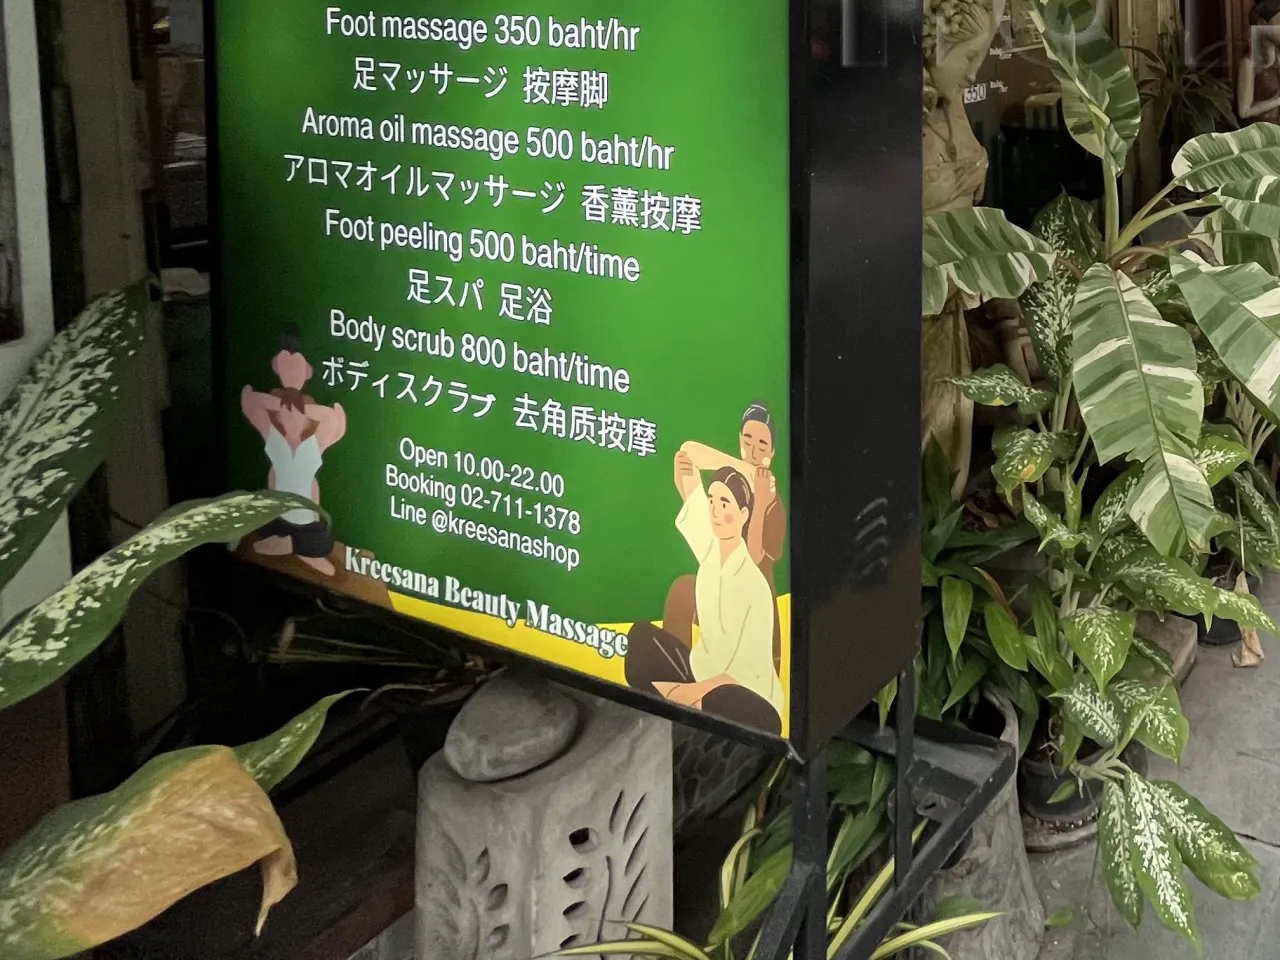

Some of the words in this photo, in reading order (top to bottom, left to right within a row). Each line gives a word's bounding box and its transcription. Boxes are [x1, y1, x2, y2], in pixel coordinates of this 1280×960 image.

[327, 8, 376, 36] Foot
[383, 17, 487, 50] massage
[495, 15, 540, 45] 350
[549, 16, 640, 50] baht/hr
[354, 57, 508, 98] 足マッサージ
[523, 66, 607, 108] 按摩脚
[302, 107, 374, 139] Aroma
[380, 115, 404, 142] oil
[412, 123, 519, 160] massage
[527, 127, 573, 159] 500
[582, 131, 674, 170] baht/hr
[284, 155, 565, 213] アロマオイルマッサージ
[326, 209, 374, 241] Foot
[381, 221, 462, 262] peeling
[470, 229, 514, 262] 500
[522, 235, 640, 281] baht/time
[407, 269, 484, 310] 足スパ
[499, 283, 552, 325] 足浴
[331, 309, 385, 351] Body
[392, 327, 454, 358] scrub
[461, 333, 506, 368] 800
[514, 342, 629, 393] baht/time
[513, 393, 656, 456] 去角质按摩
[386, 464, 456, 507] Booking
[461, 486, 580, 534] 02-711-1378
[400, 438, 447, 468] Open
[454, 451, 564, 497] 10.00-22.00
[391, 496, 426, 525] Line
[432, 509, 580, 571] @kreesanashop
[346, 547, 439, 597] Kreesana
[445, 576, 520, 625] Beauty
[527, 600, 628, 657] Massage
